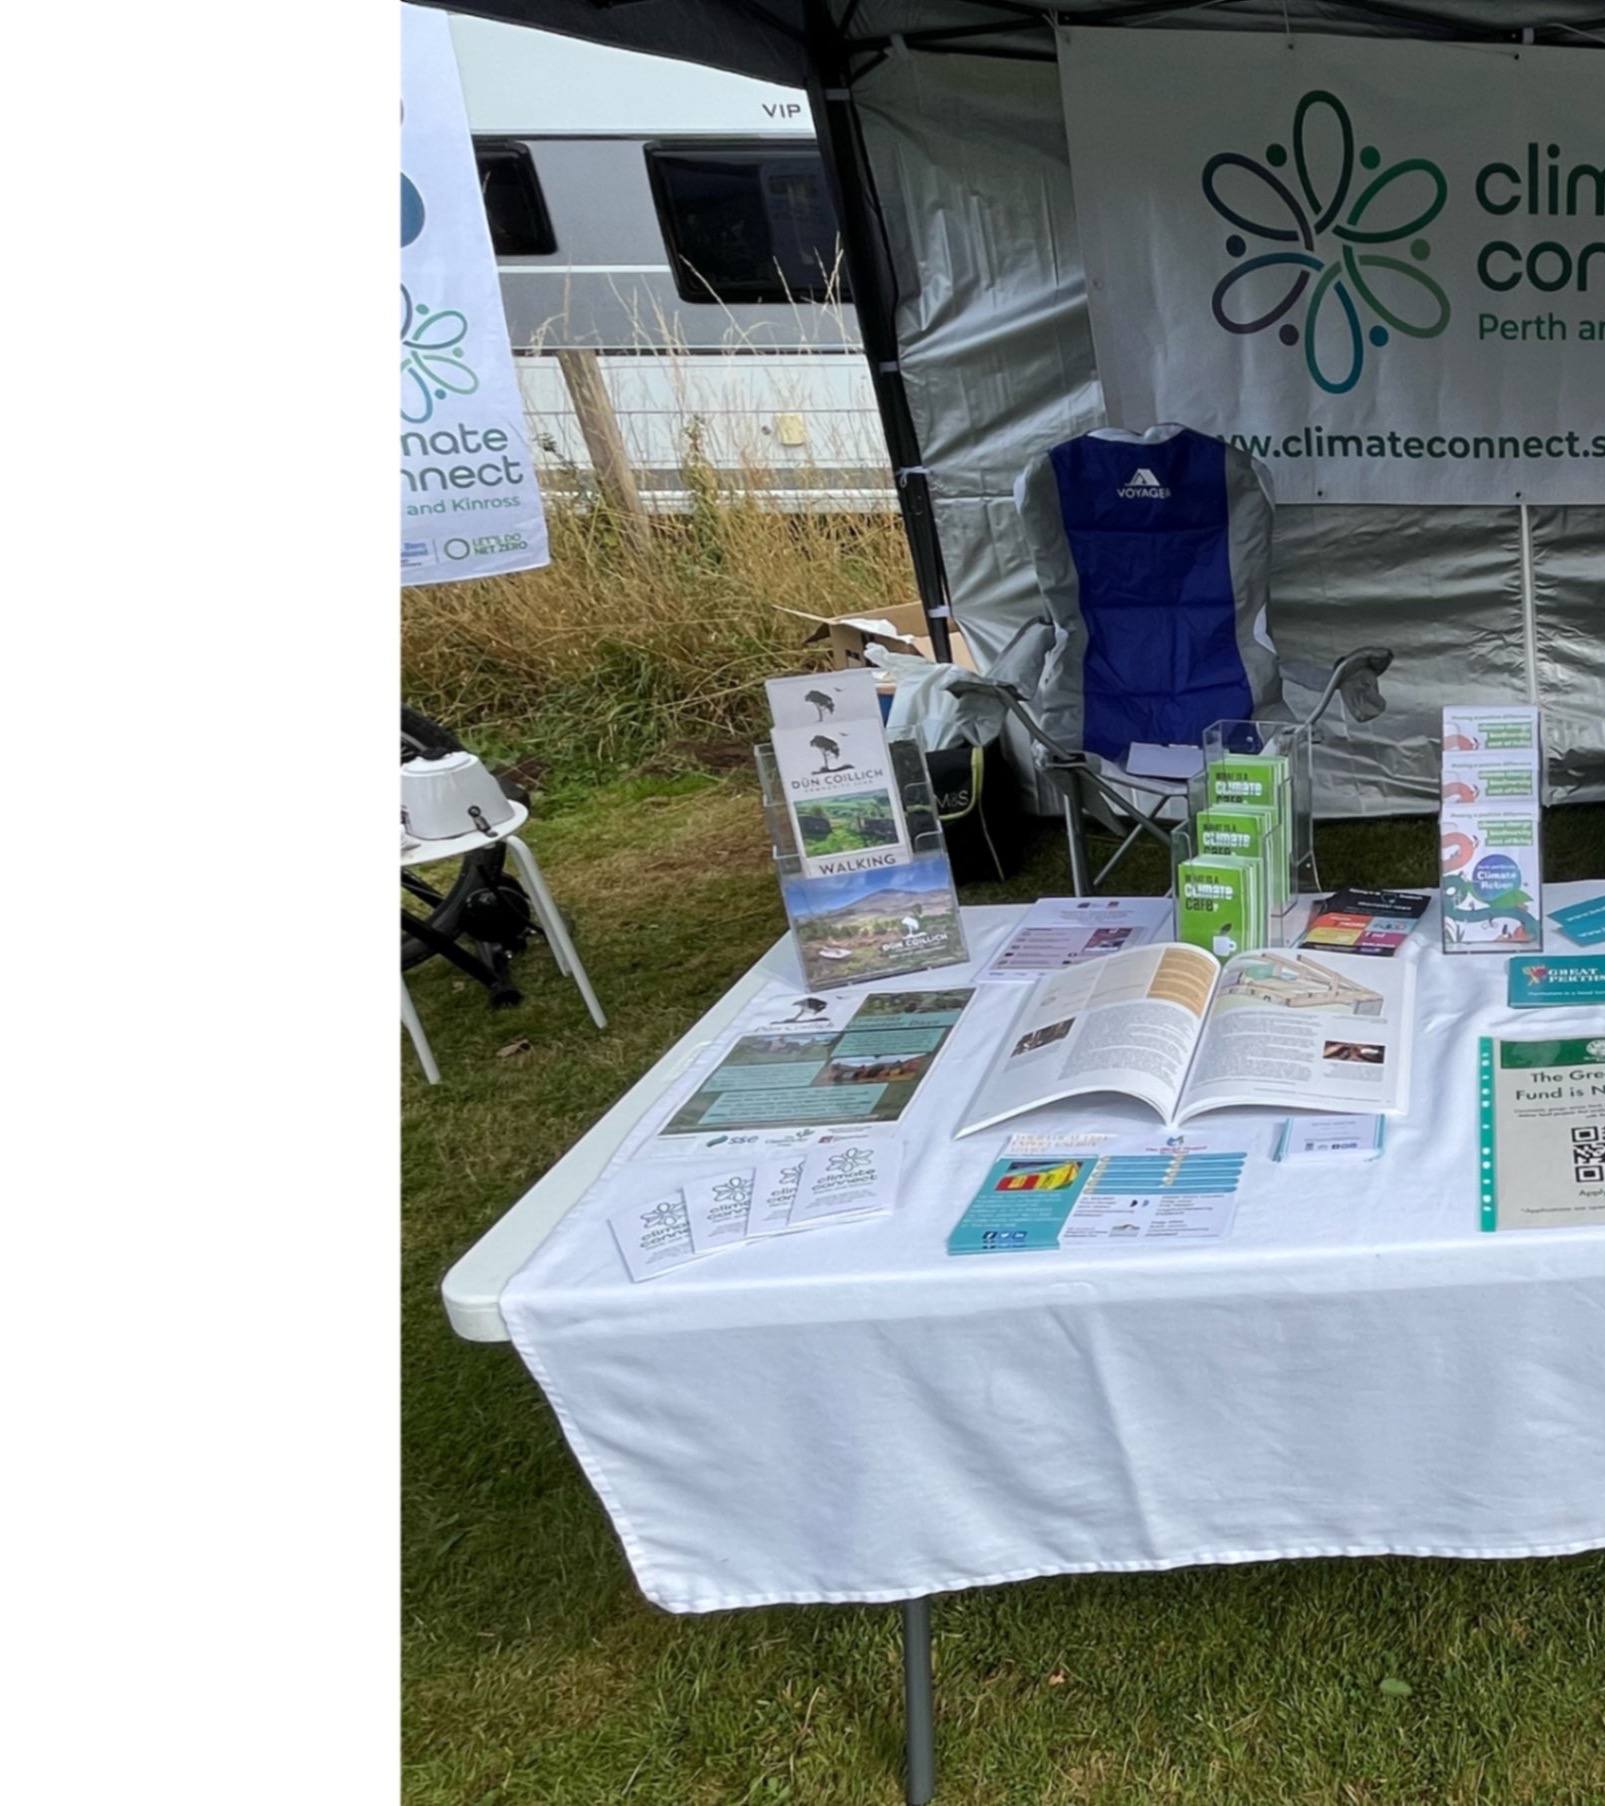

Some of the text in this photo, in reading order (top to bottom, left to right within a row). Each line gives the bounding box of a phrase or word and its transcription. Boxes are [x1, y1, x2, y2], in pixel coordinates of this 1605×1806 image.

[762, 103, 801, 118] VIP
[1478, 313, 1568, 344] Perth
[407, 496, 521, 515] and Kinross
[824, 769, 884, 786] COILLICH
[938, 790, 970, 807] M&S
[819, 853, 896, 876] WALKING
[1477, 871, 1517, 880] Climate
[1547, 968, 1599, 976] GREAT
[1531, 1071, 1563, 1083] The
[1515, 1088, 1563, 1101] Fund
[1571, 1087, 1584, 1097] is
[811, 1174, 878, 1191] connect
[817, 1168, 876, 1184] climate
